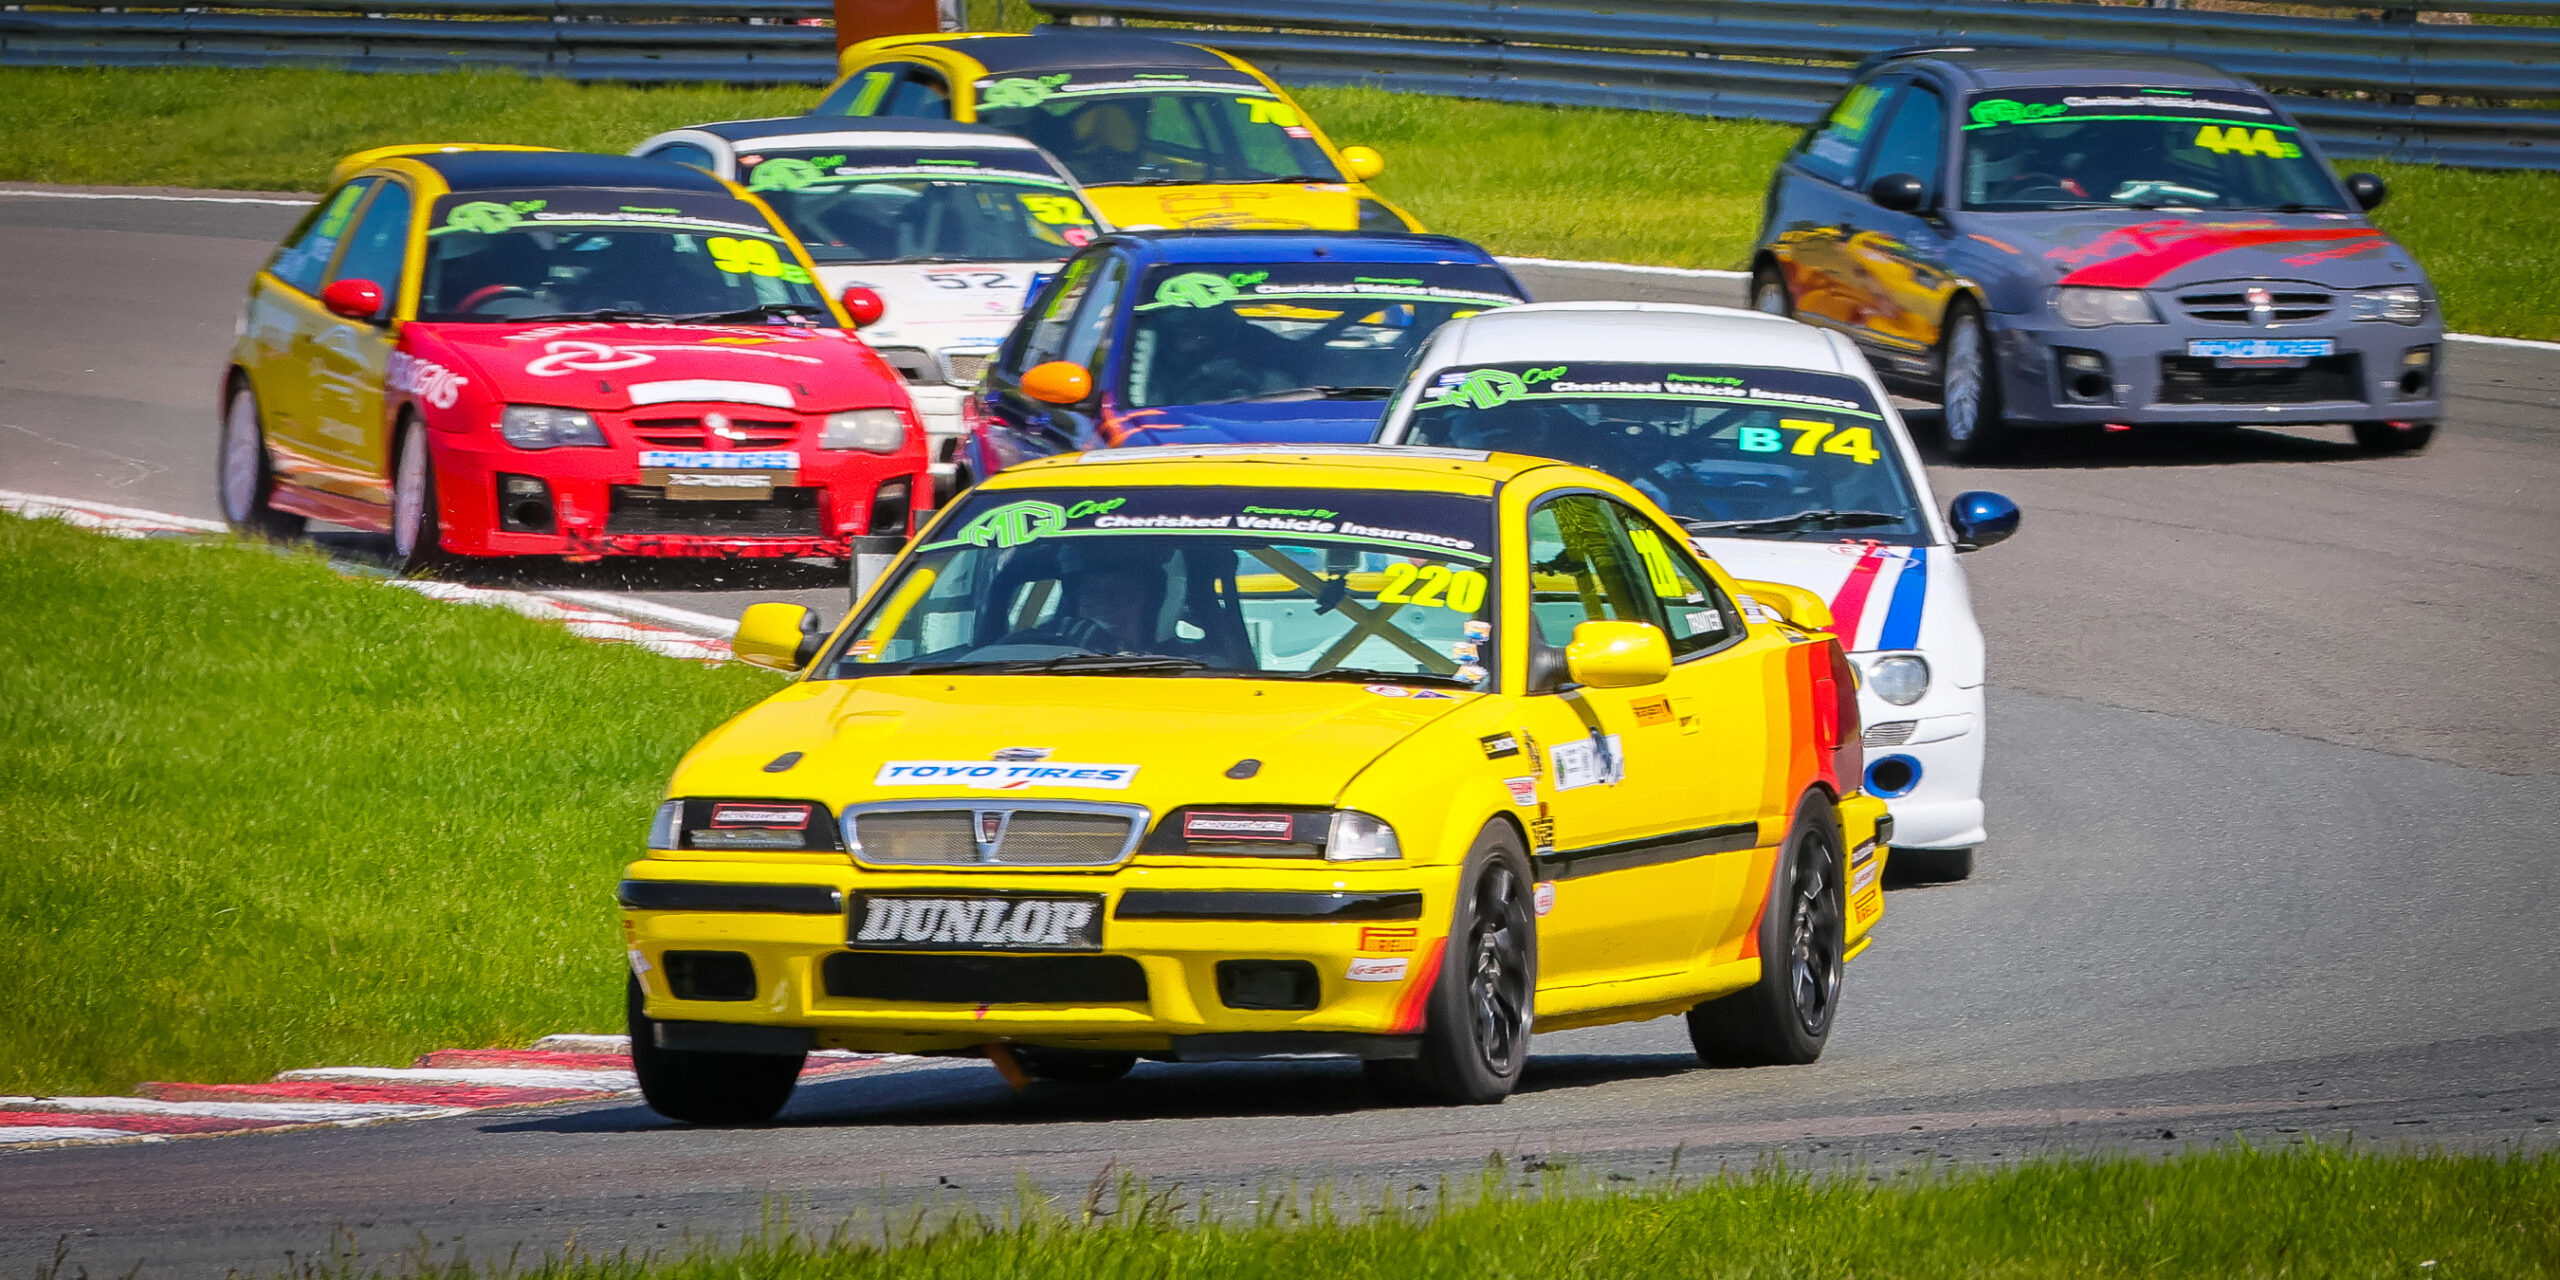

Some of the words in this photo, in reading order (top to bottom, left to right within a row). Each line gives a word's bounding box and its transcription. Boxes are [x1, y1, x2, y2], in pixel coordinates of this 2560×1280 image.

[2194, 125, 2284, 158] 444
[1020, 196, 1095, 225] 52
[706, 237, 783, 277] 99
[926, 273, 1020, 289] 52
[1438, 368, 1528, 410] MG
[1551, 381, 1661, 394] Cherished
[1664, 381, 1748, 397] Vehicle
[1750, 388, 1860, 409] Insurance
[1739, 427, 1782, 452] B
[1779, 418, 1880, 465] 74
[958, 499, 1067, 549] MG
[1243, 505, 1312, 518] Powered
[1312, 509, 1339, 520] By
[1094, 515, 1232, 529] Cherished
[1236, 515, 1337, 533] Vehicle
[1339, 521, 1475, 551] Insurance
[1376, 562, 1488, 613] 220
[890, 765, 998, 778] TOYO
[1006, 766, 1129, 782] TIRES
[857, 898, 1094, 944] DUNLOP
